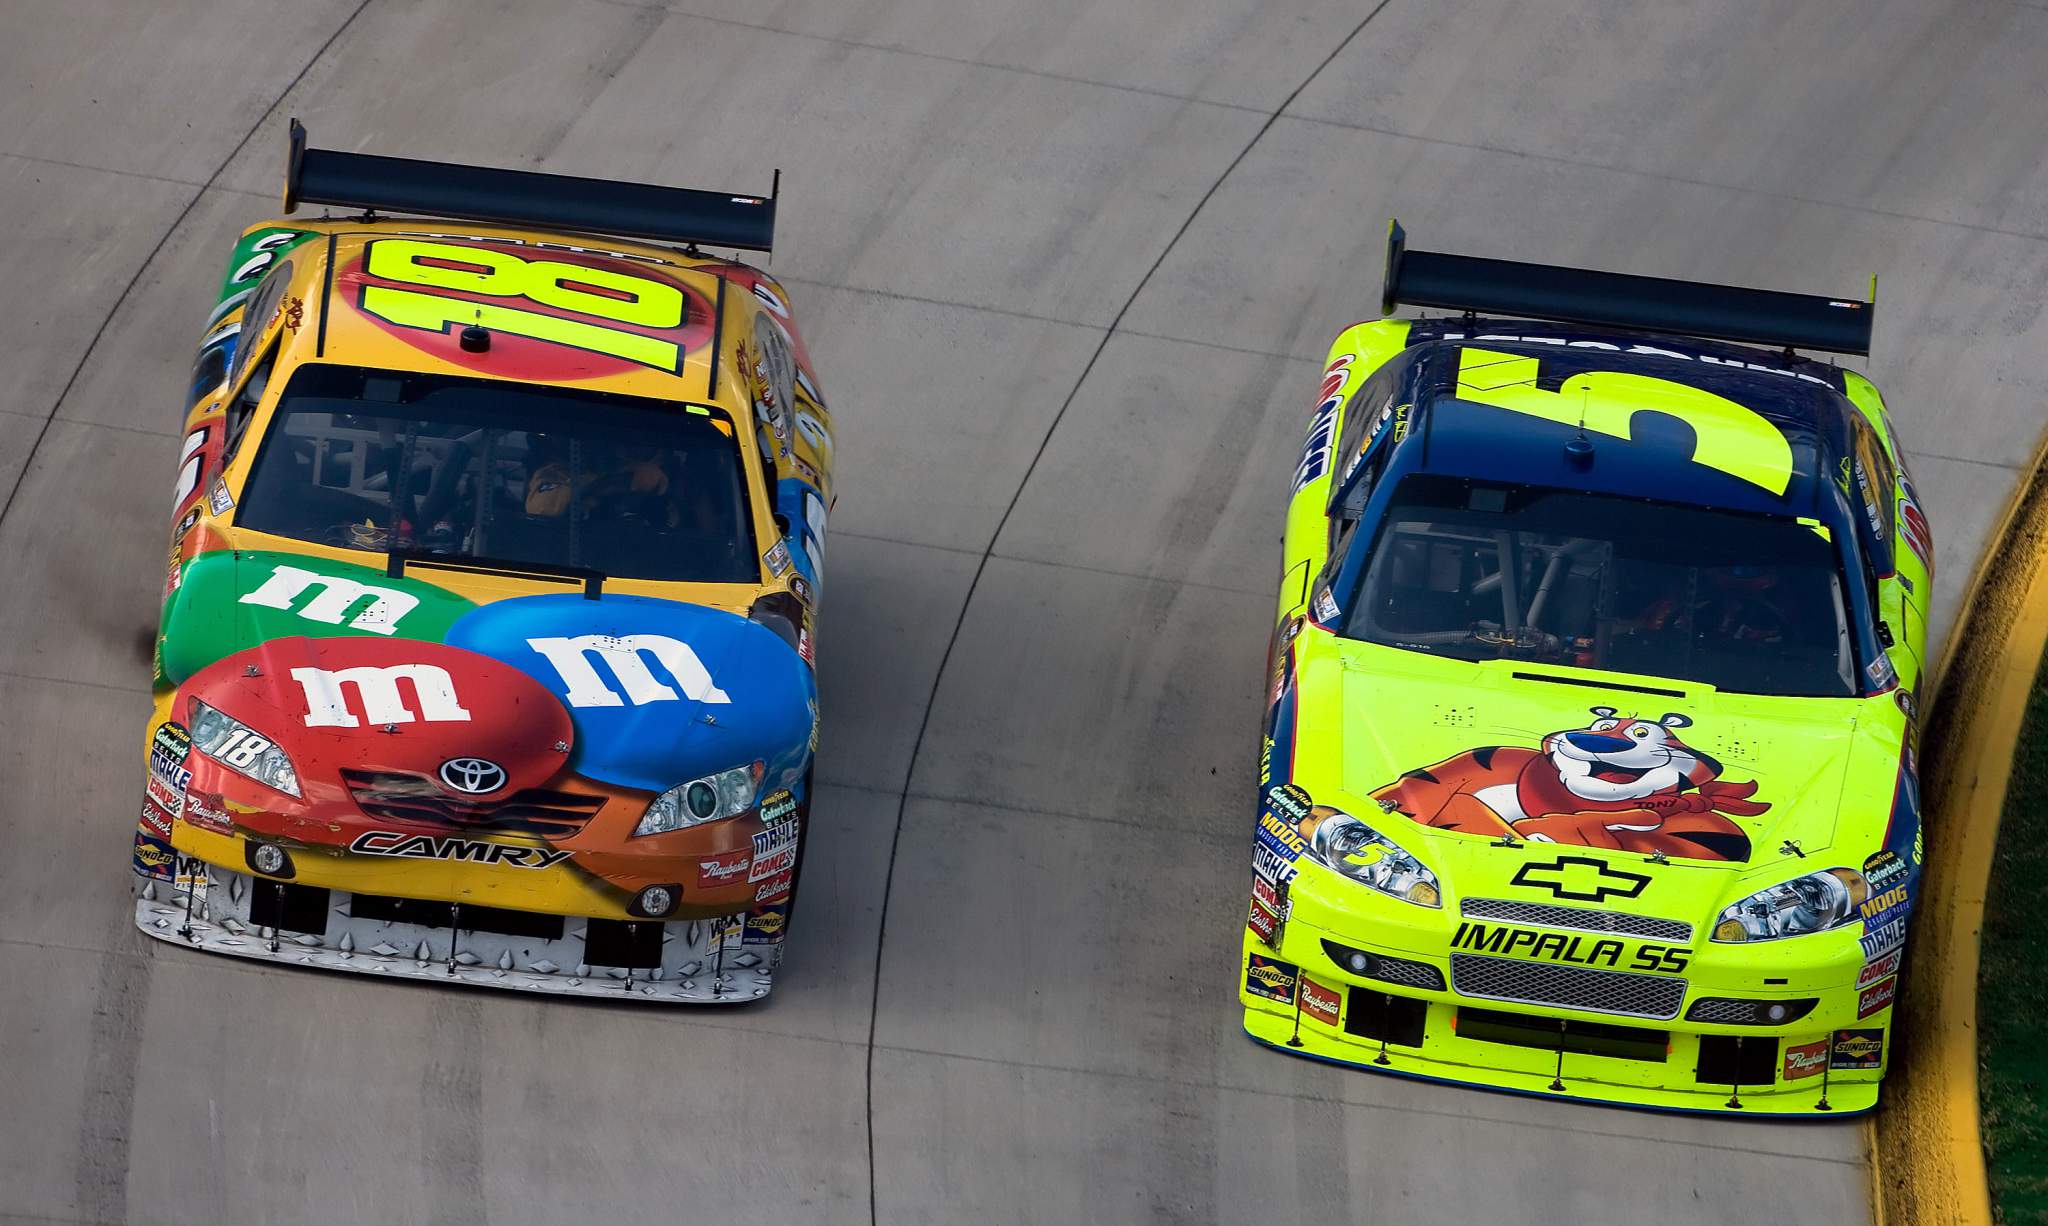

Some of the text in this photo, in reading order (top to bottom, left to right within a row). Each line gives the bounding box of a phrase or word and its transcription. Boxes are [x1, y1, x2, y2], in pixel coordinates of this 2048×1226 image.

[358, 238, 687, 377] 18
[1456, 347, 1793, 496] 5
[238, 564, 420, 635] m
[526, 634, 731, 707] m
[290, 664, 471, 728] m
[211, 728, 272, 768] 18
[151, 749, 192, 792] MAHLE
[766, 811, 797, 829] BELTS
[1266, 797, 1297, 823] BELTS
[1269, 786, 1308, 819] Gatorback
[1633, 799, 1677, 809] TONY
[350, 830, 577, 870] CAMRY
[753, 821, 798, 854] MAHLE
[1260, 811, 1308, 854] MOOG
[1343, 842, 1398, 866] 5
[1865, 857, 1906, 884] Gatorback
[1874, 869, 1909, 890] BELTS
[1860, 883, 1908, 919] MOOG
[1450, 922, 1693, 973] IMPALA SS
[1859, 917, 1905, 957] MAHLE
[1250, 967, 1293, 986] SUNOCO
[1837, 1042, 1881, 1052] SUNOCO
